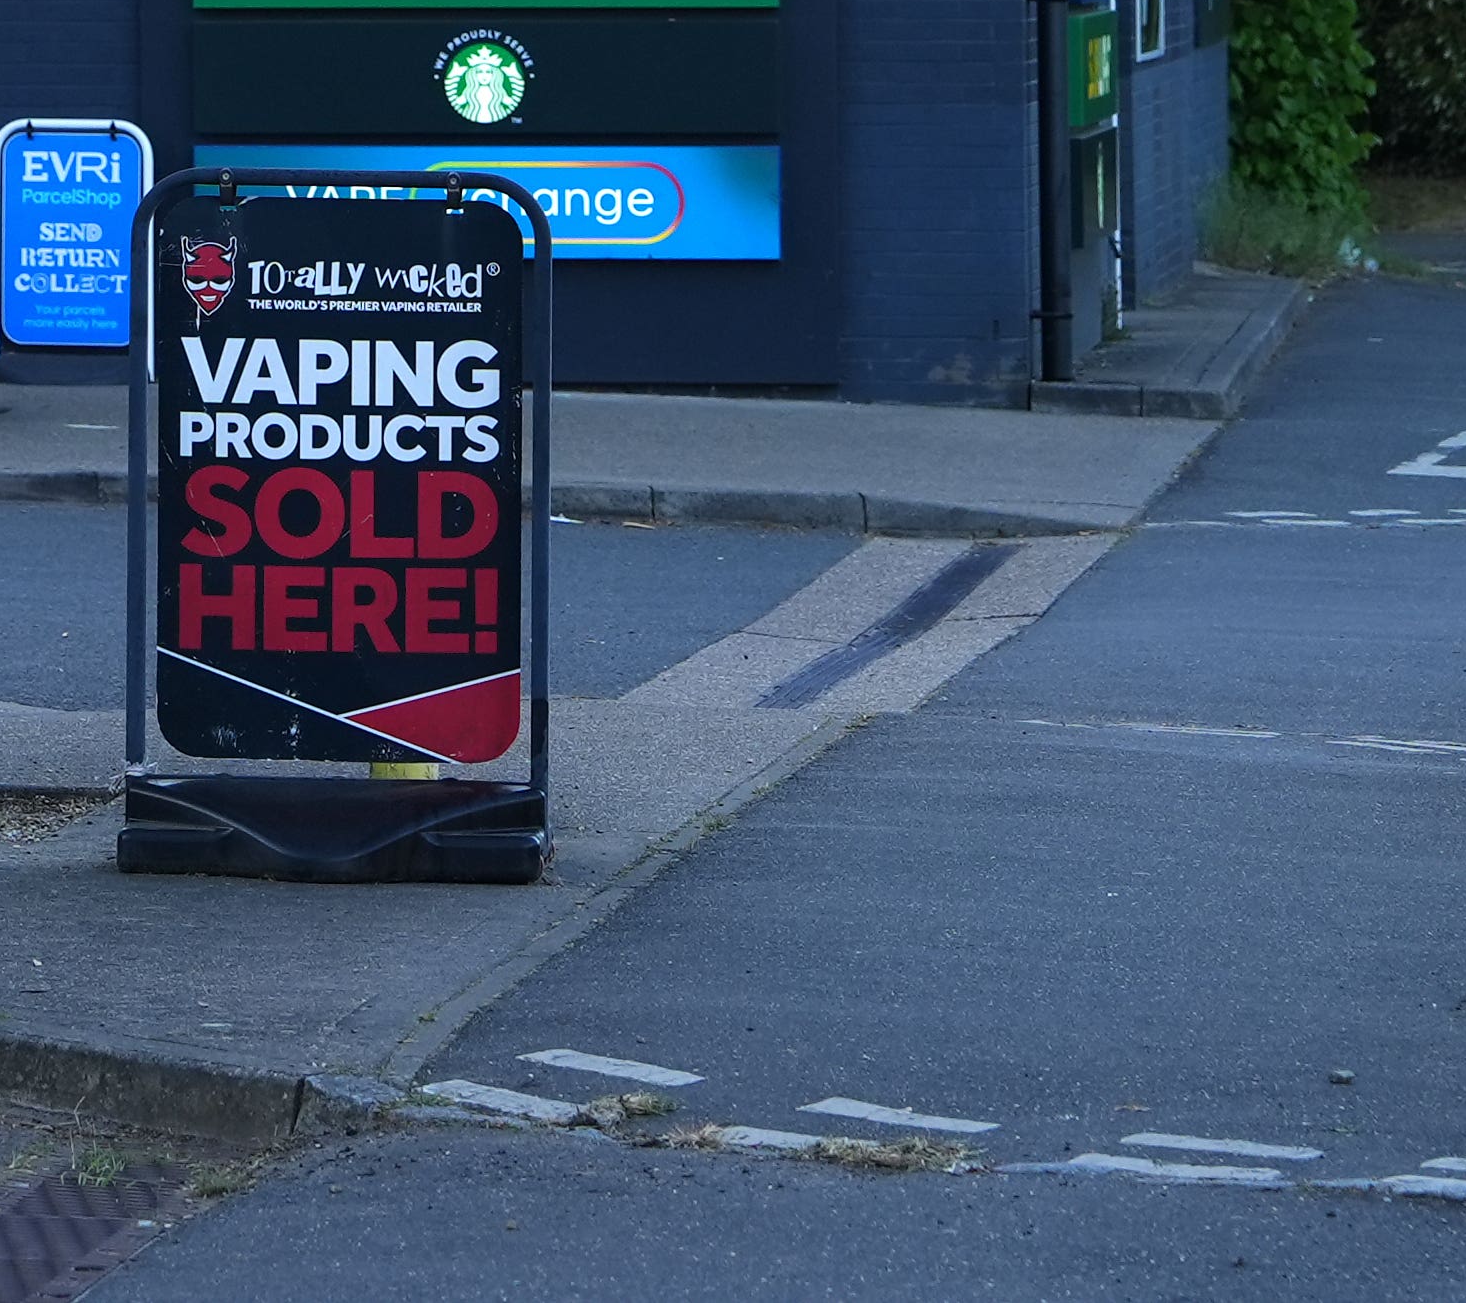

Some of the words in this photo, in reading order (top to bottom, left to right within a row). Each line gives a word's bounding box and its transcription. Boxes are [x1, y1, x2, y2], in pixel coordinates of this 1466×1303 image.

[433, 50, 449, 70] WE
[446, 28, 502, 52] PROUDLY
[503, 35, 534, 68] SERVE
[22, 188, 121, 209] ParcelShop
[39, 222, 103, 242] SEND
[20, 247, 120, 268] RETURN
[14, 273, 128, 294] COLLECT
[248, 299, 272, 309] THE
[273, 299, 328, 311] WORLD'S
[329, 300, 379, 311] PREMIER
[382, 301, 424, 312] VAPING
[426, 302, 482, 313] RETAILER
[181, 337, 501, 408] VAPING
[180, 412, 500, 462] PRODUCTS
[181, 465, 500, 560] SOLD
[178, 564, 499, 654] HERE!
